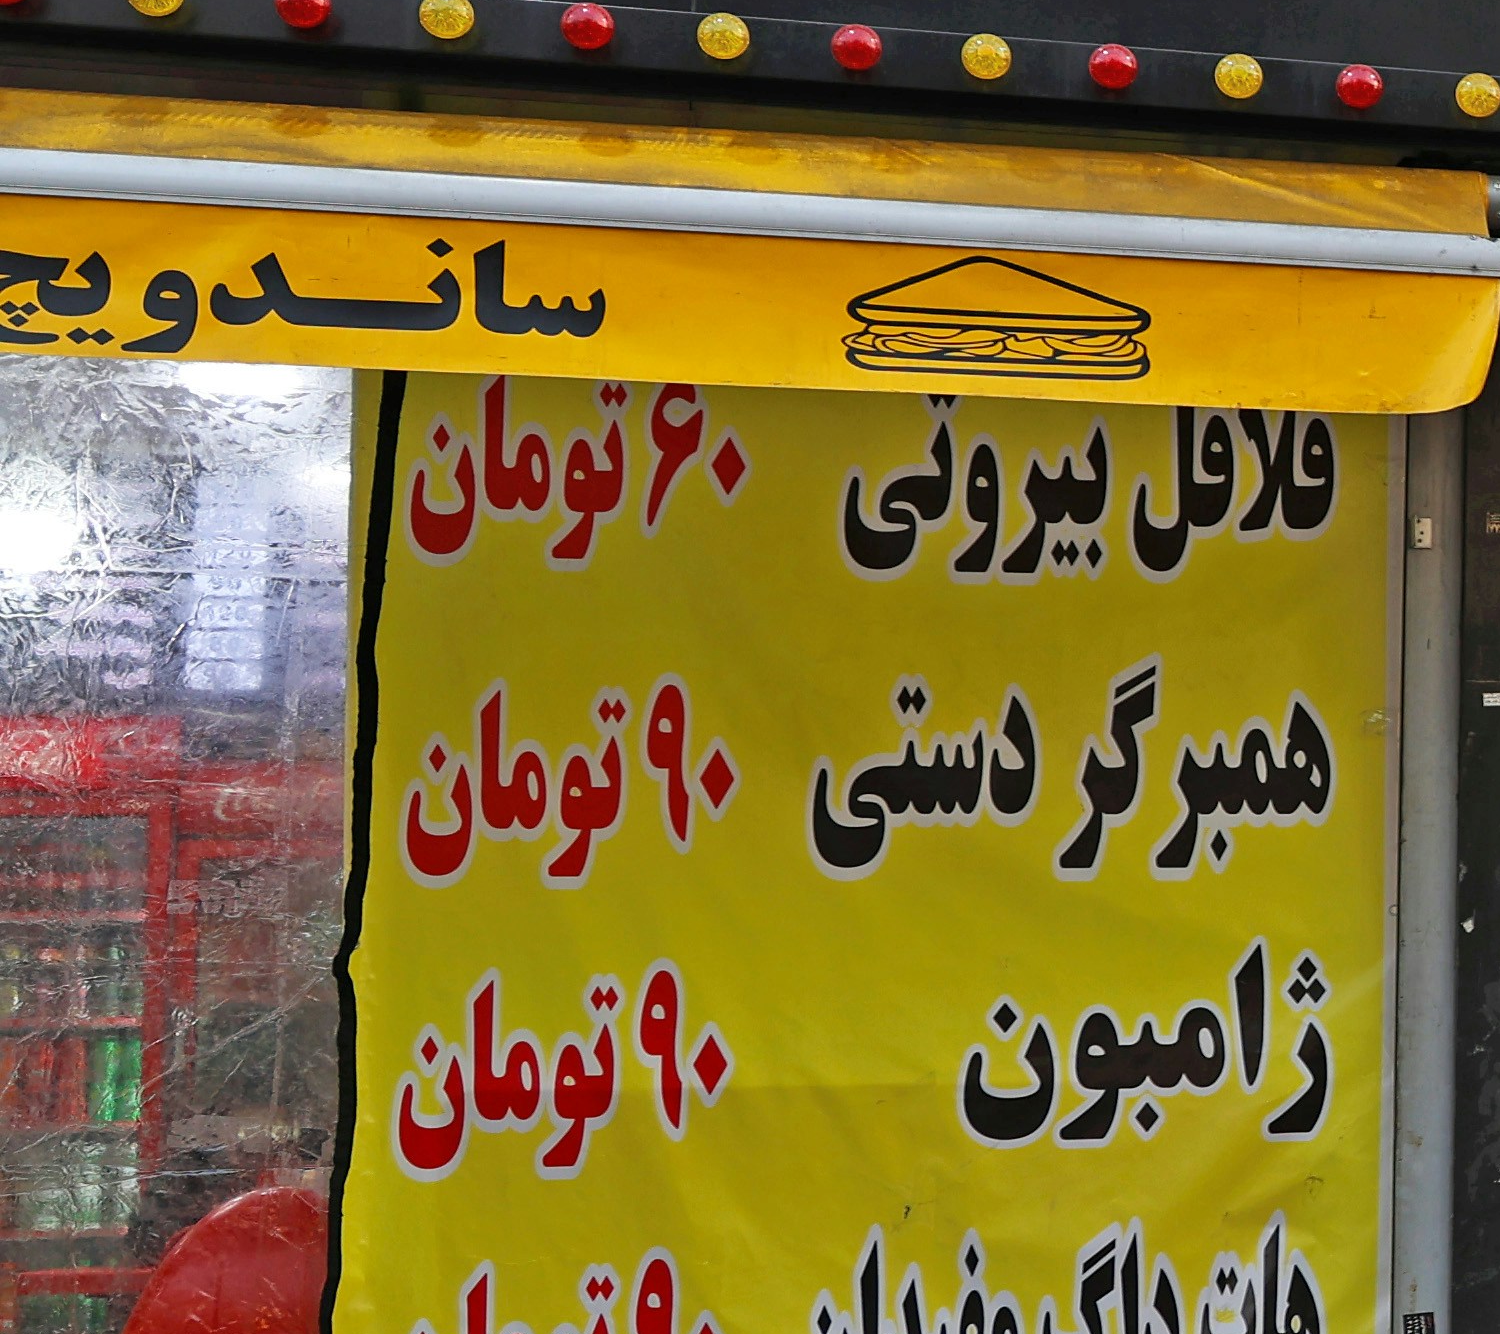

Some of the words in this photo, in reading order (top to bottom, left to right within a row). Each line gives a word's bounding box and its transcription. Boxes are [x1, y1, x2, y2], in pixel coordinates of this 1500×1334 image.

[413, 375, 624, 559] تومان
[1134, 412, 1334, 571] فلافل
[409, 691, 625, 876] تومان
[648, 685, 735, 841] ۹۰
[814, 686, 1035, 868] دستی
[1060, 666, 1330, 868] همبرگر
[399, 980, 617, 1170] تومان
[640, 970, 731, 1129] ۹۰
[964, 945, 1327, 1140] ژامبون
